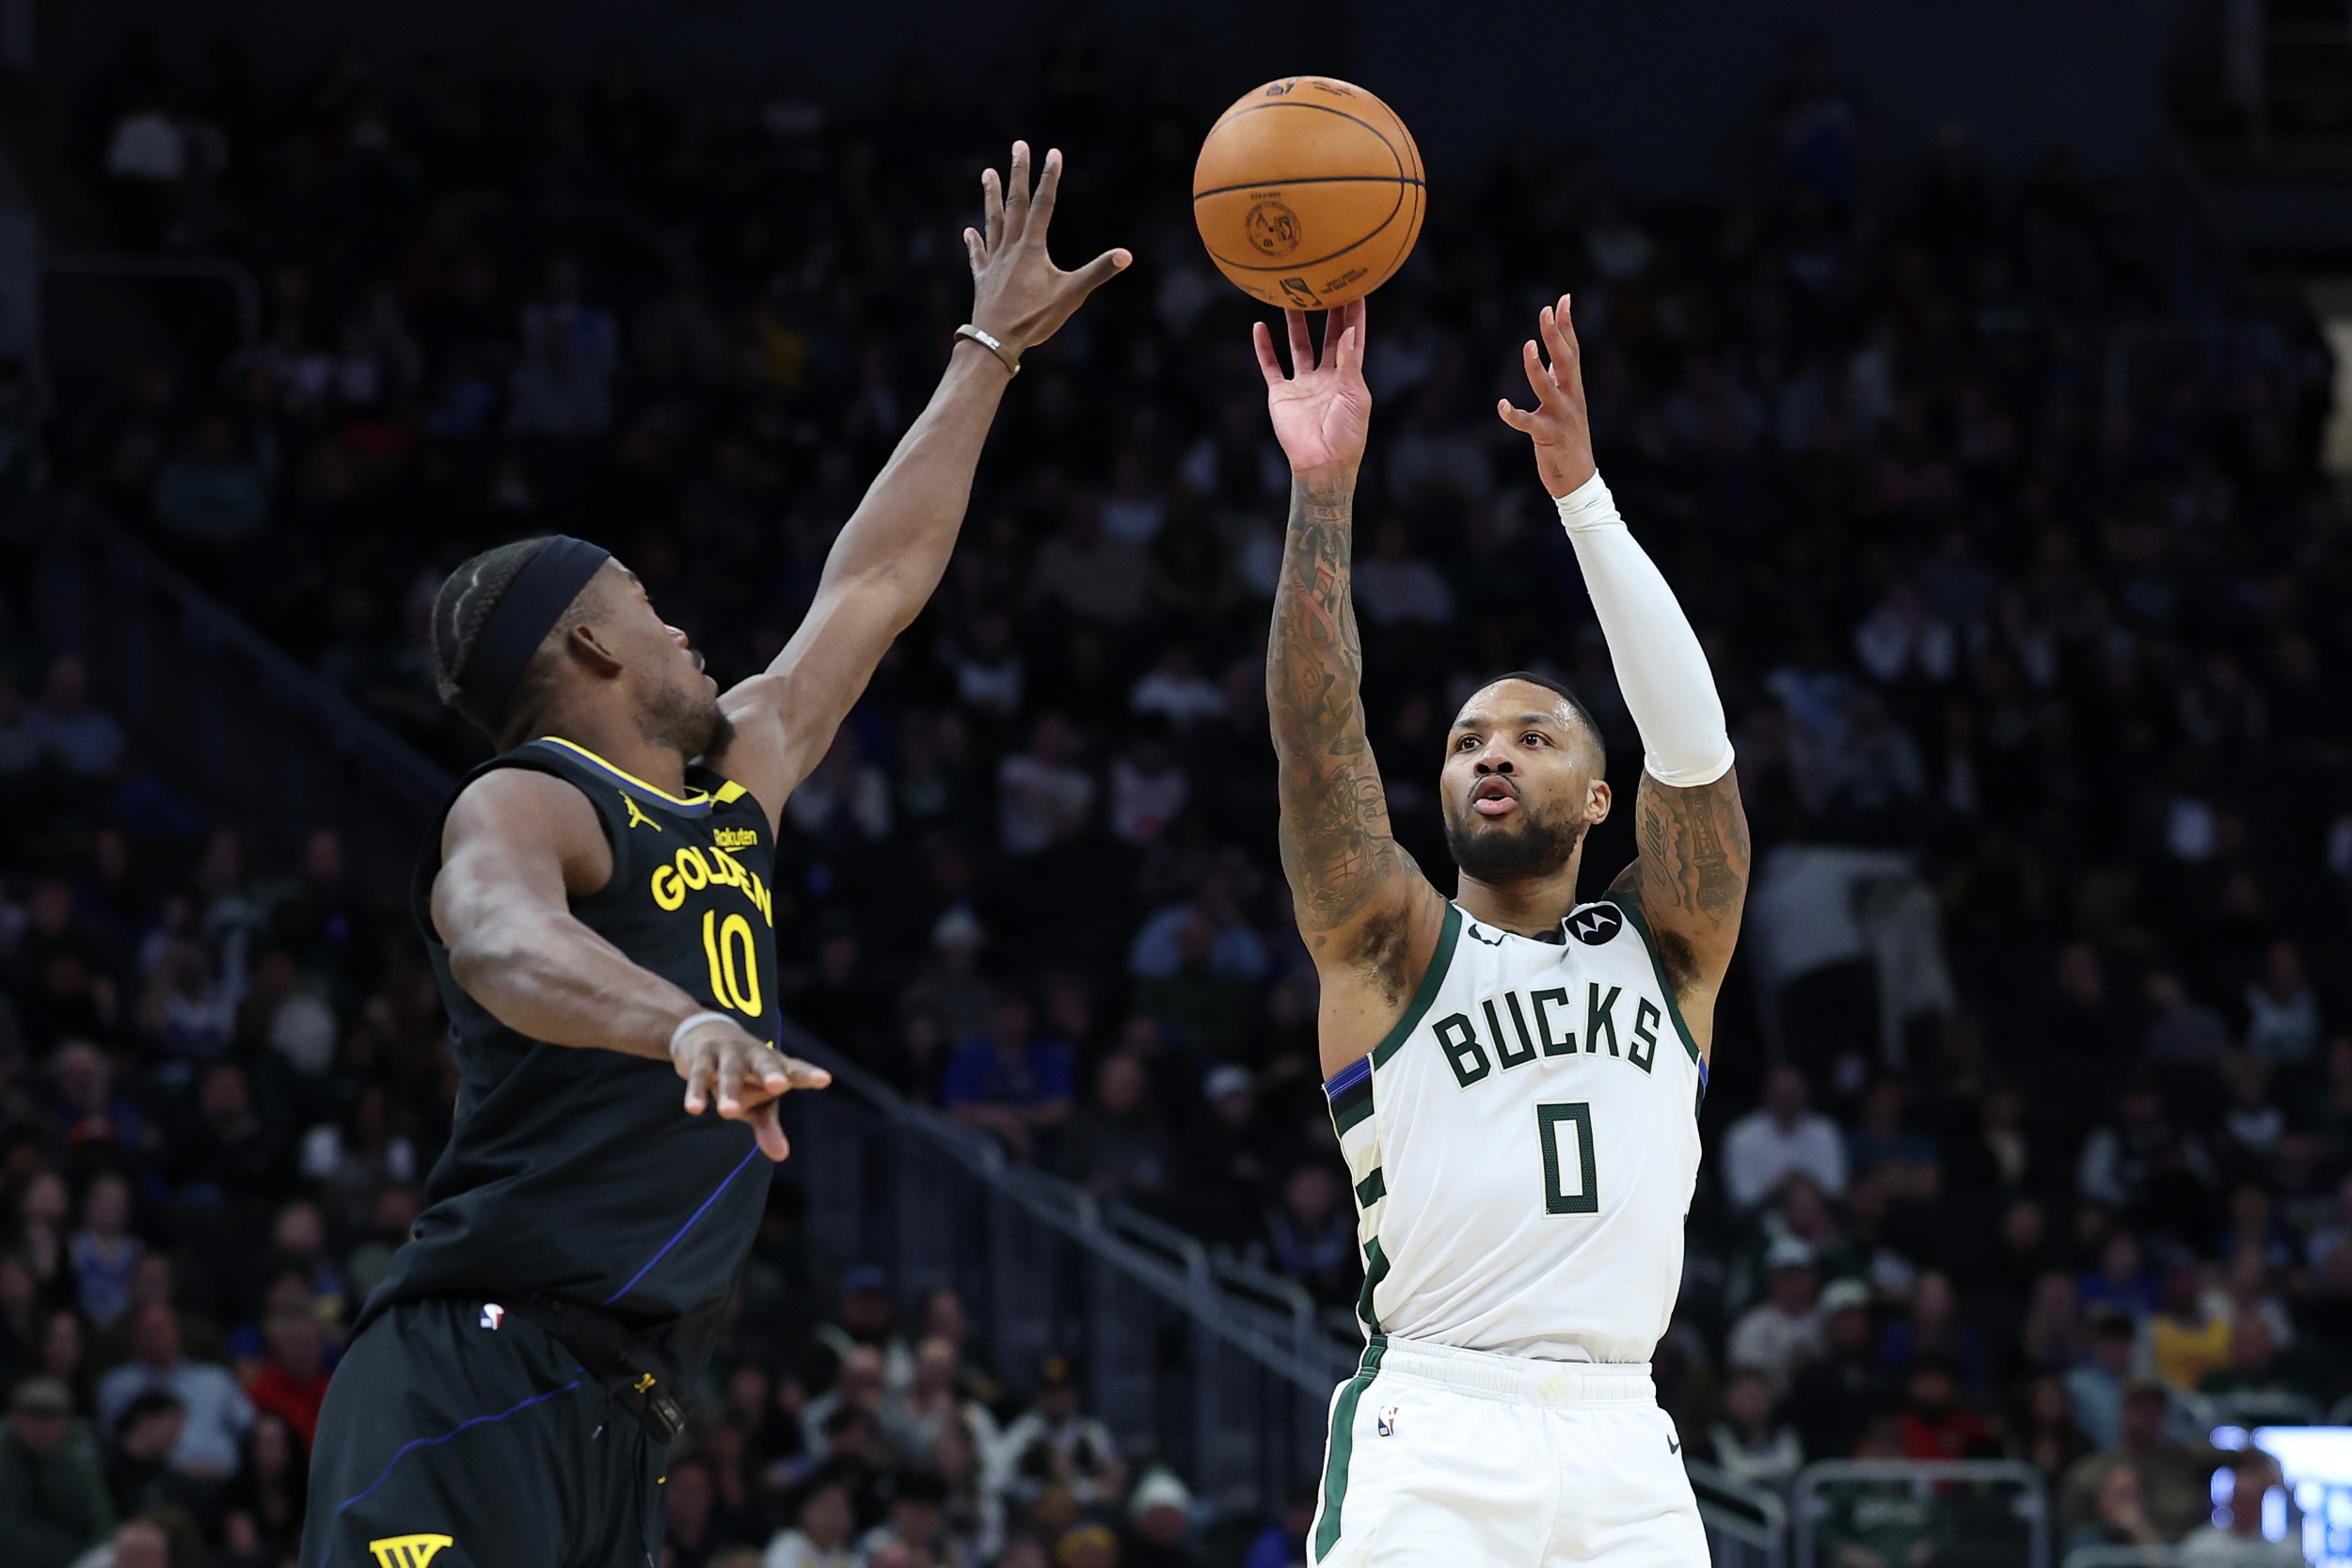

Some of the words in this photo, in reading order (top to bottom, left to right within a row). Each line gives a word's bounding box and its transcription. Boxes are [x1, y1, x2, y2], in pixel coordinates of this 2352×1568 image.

[651, 846, 773, 928] GOLDEN
[713, 827, 758, 847] Rakuten
[703, 909, 763, 1018] 10
[1431, 979, 1662, 1092] BUCKS
[1534, 1101, 1600, 1218] 0
